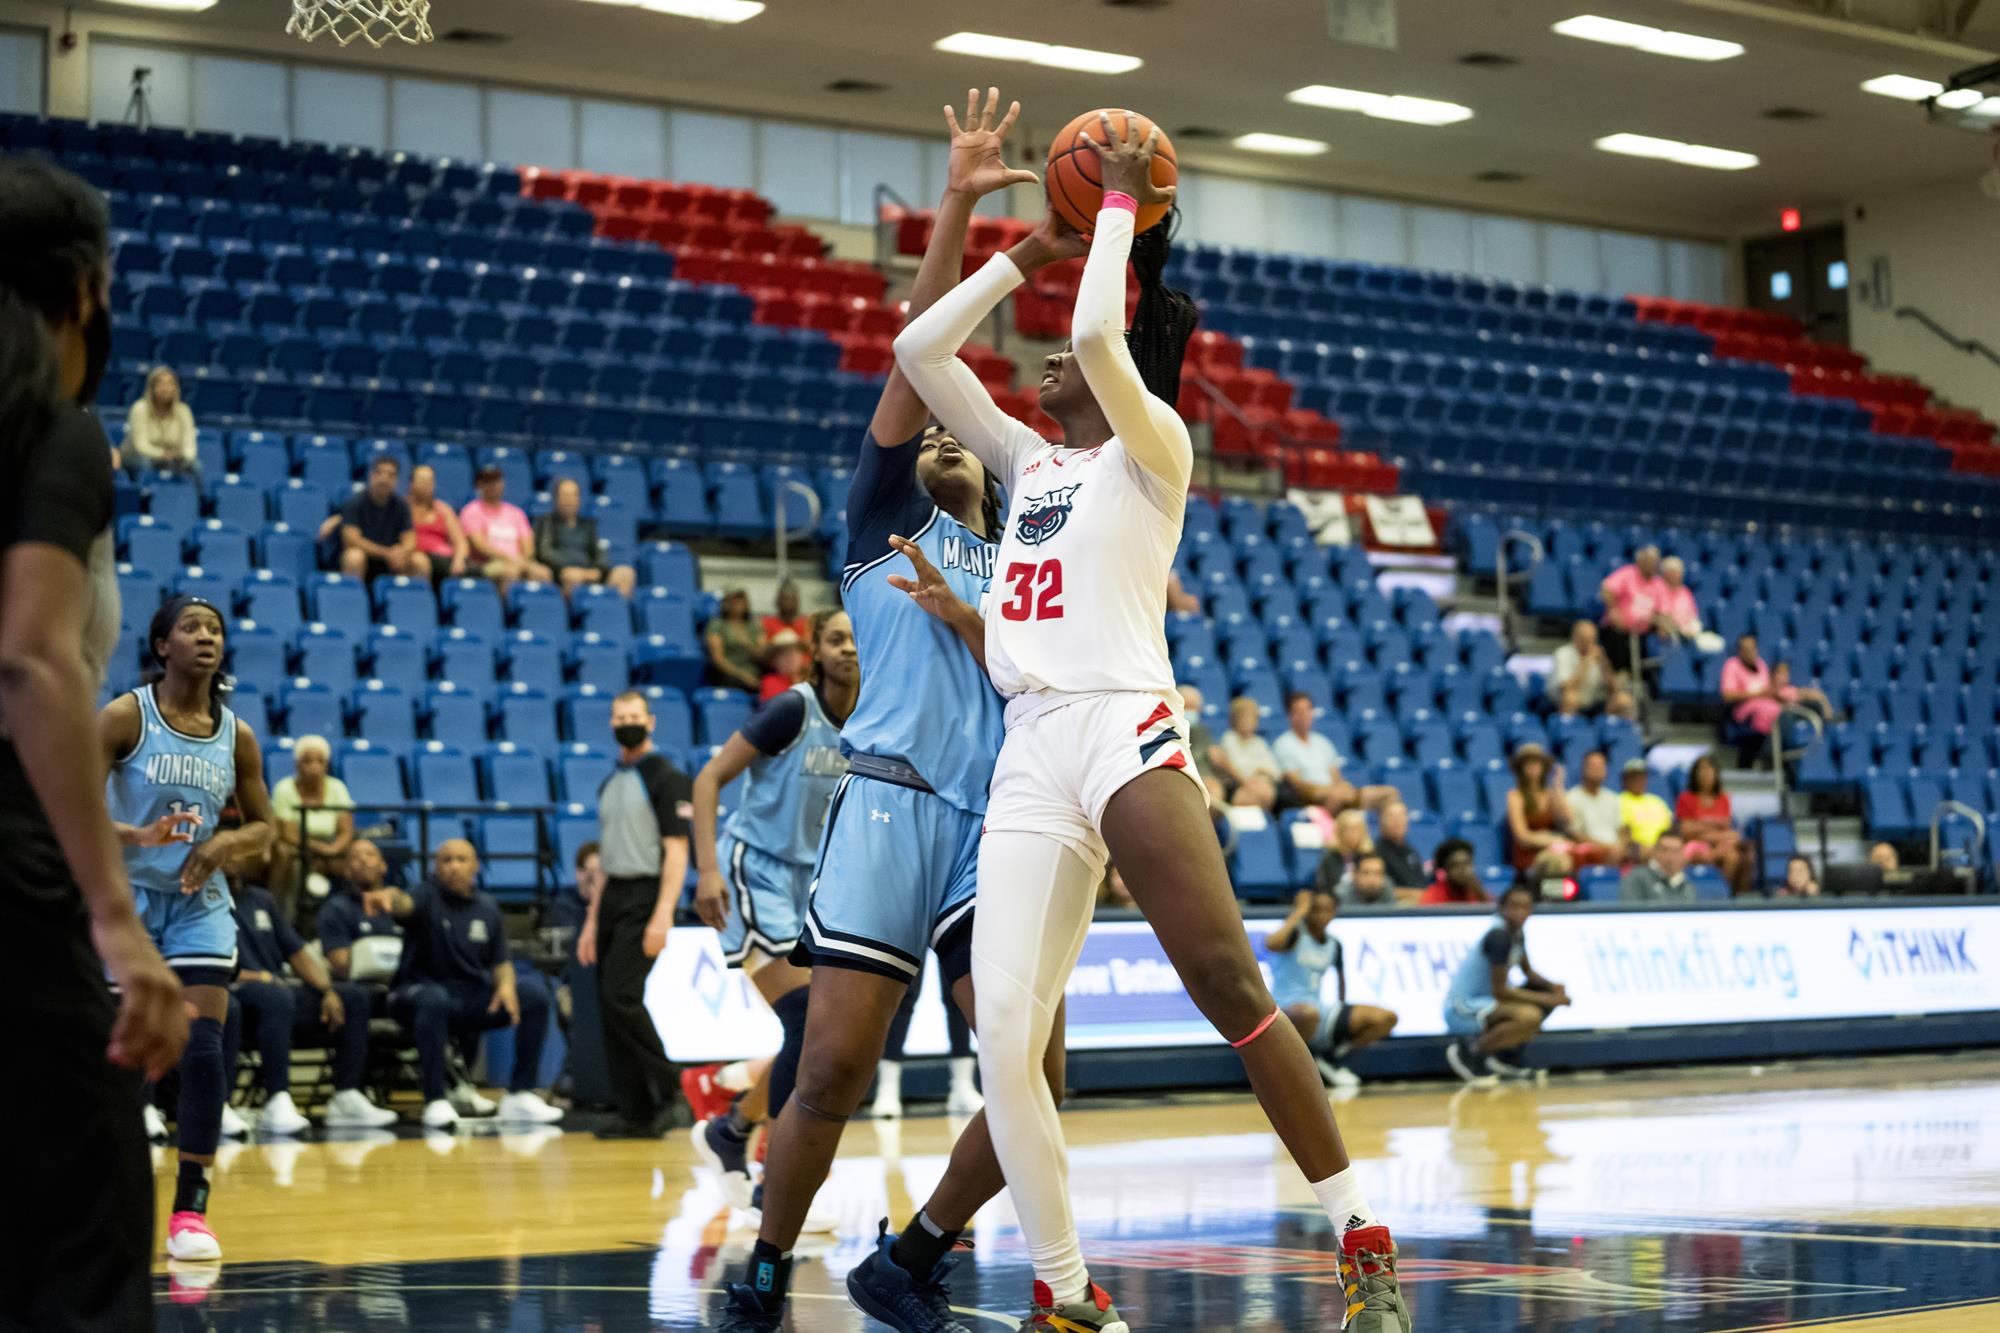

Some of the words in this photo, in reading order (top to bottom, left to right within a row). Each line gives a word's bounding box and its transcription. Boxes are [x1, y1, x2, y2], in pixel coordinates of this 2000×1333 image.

[1001, 558, 1064, 622] 32
[144, 753, 227, 801] MONARCHS
[1581, 929, 1799, 999] ithinkfi.org
[1873, 927, 1979, 976] iTHINK
